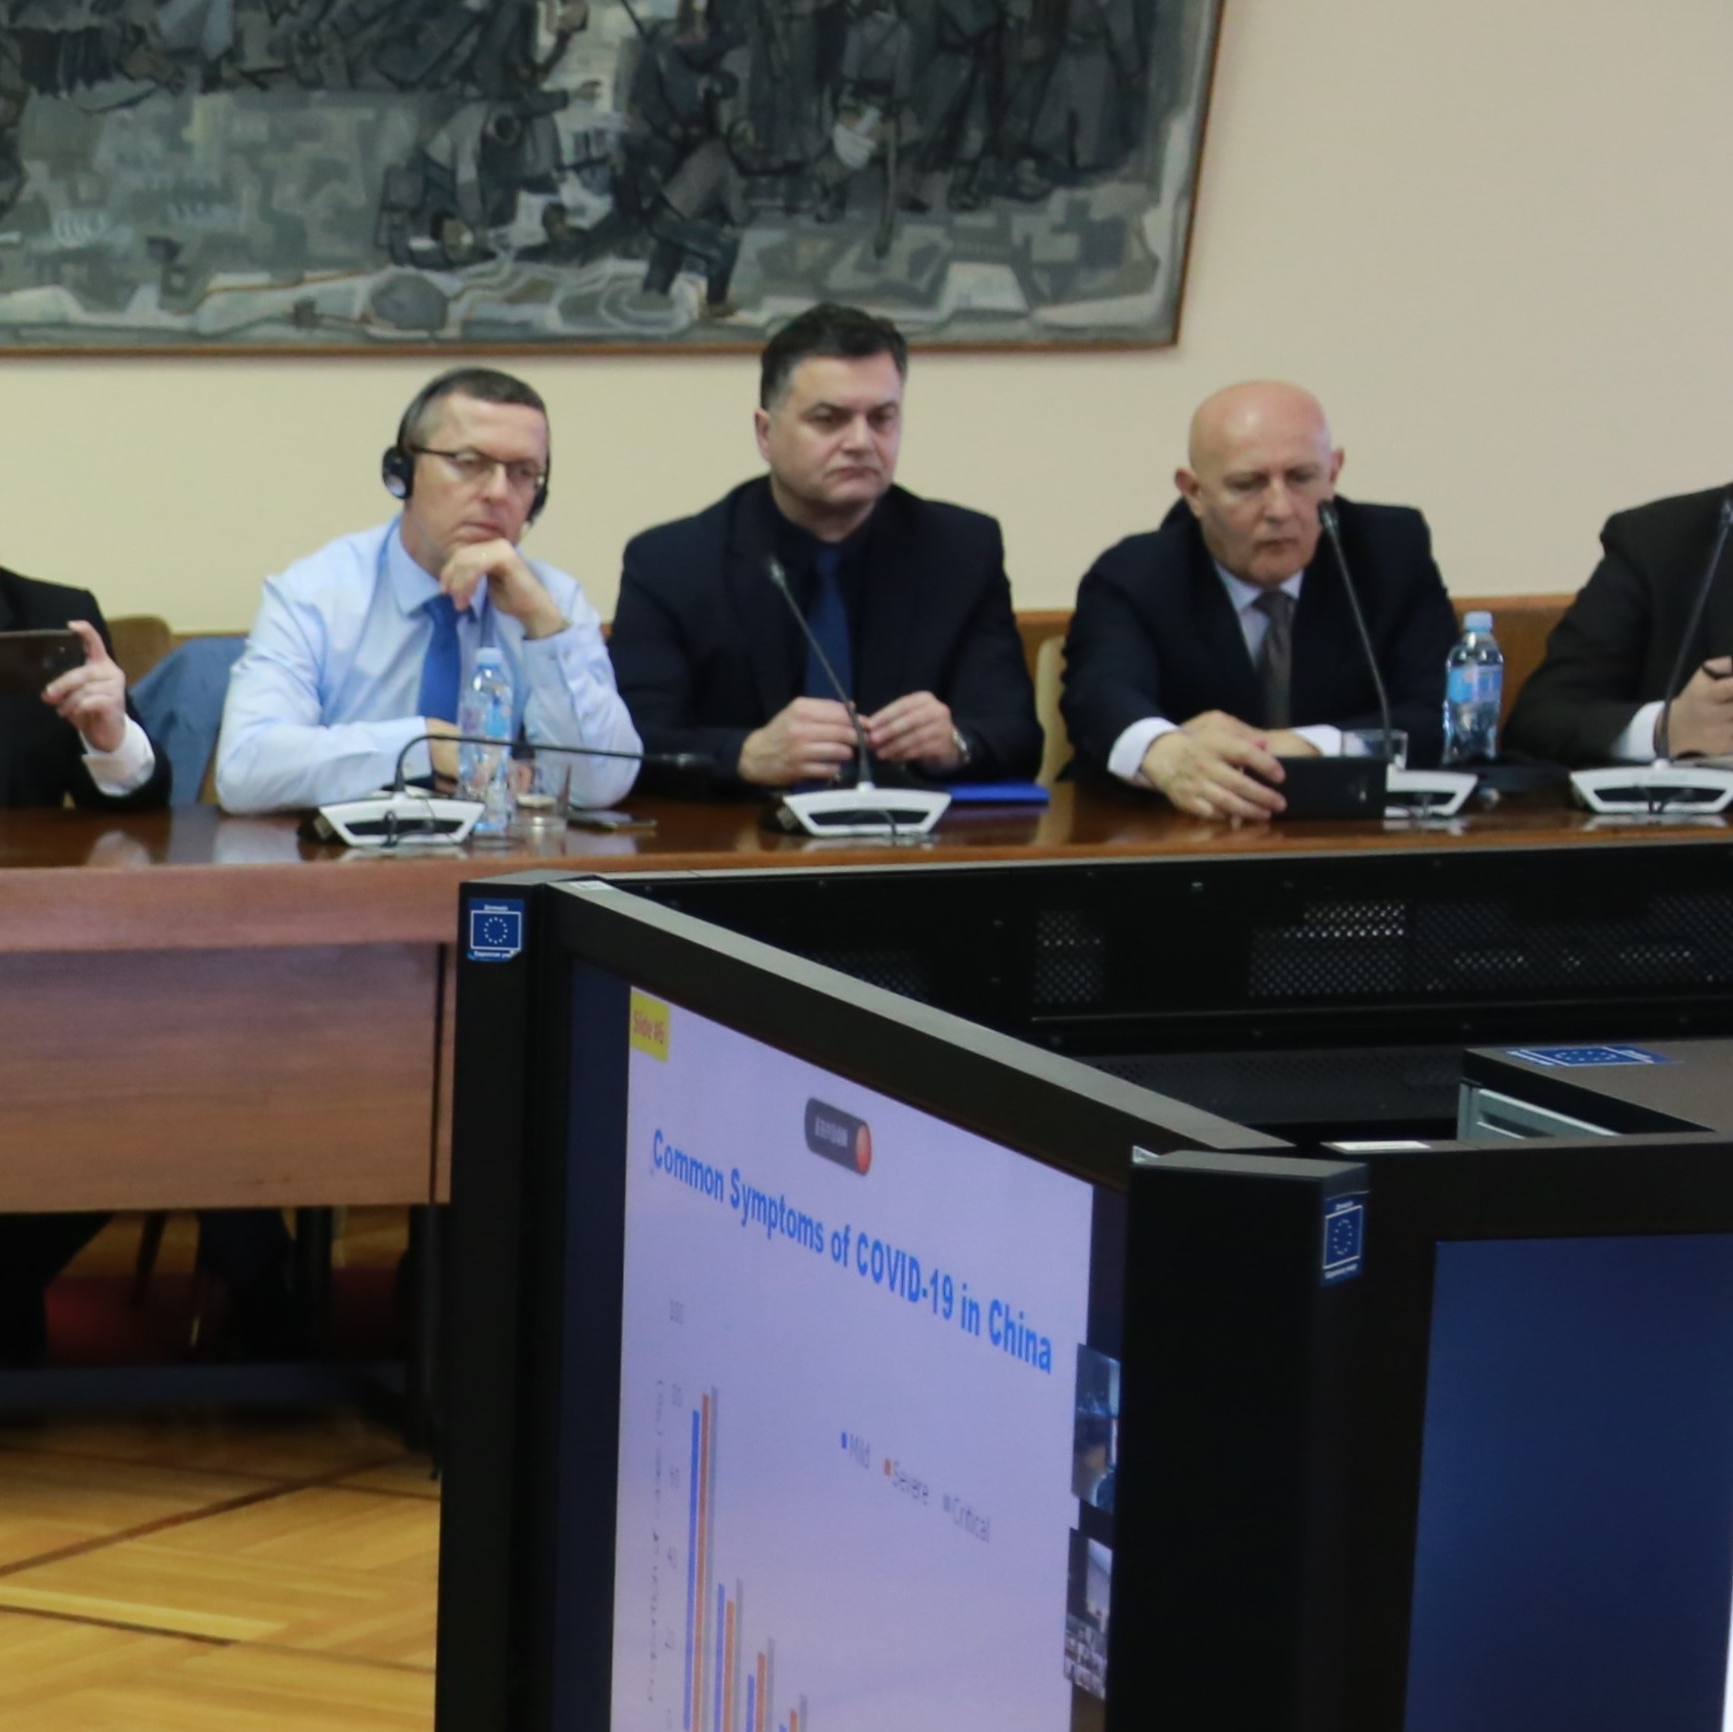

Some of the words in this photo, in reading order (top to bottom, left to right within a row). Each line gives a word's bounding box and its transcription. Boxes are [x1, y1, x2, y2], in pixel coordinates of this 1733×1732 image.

[652, 1128, 724, 1204] Common
[729, 1168, 825, 1253] Symptoms
[830, 1223, 851, 1268] of
[856, 1231, 955, 1321] COVID-19
[960, 1282, 981, 1338] in
[988, 1299, 1053, 1375] China
[893, 1459, 929, 1507] Severe
[953, 1496, 992, 1544] Critical
